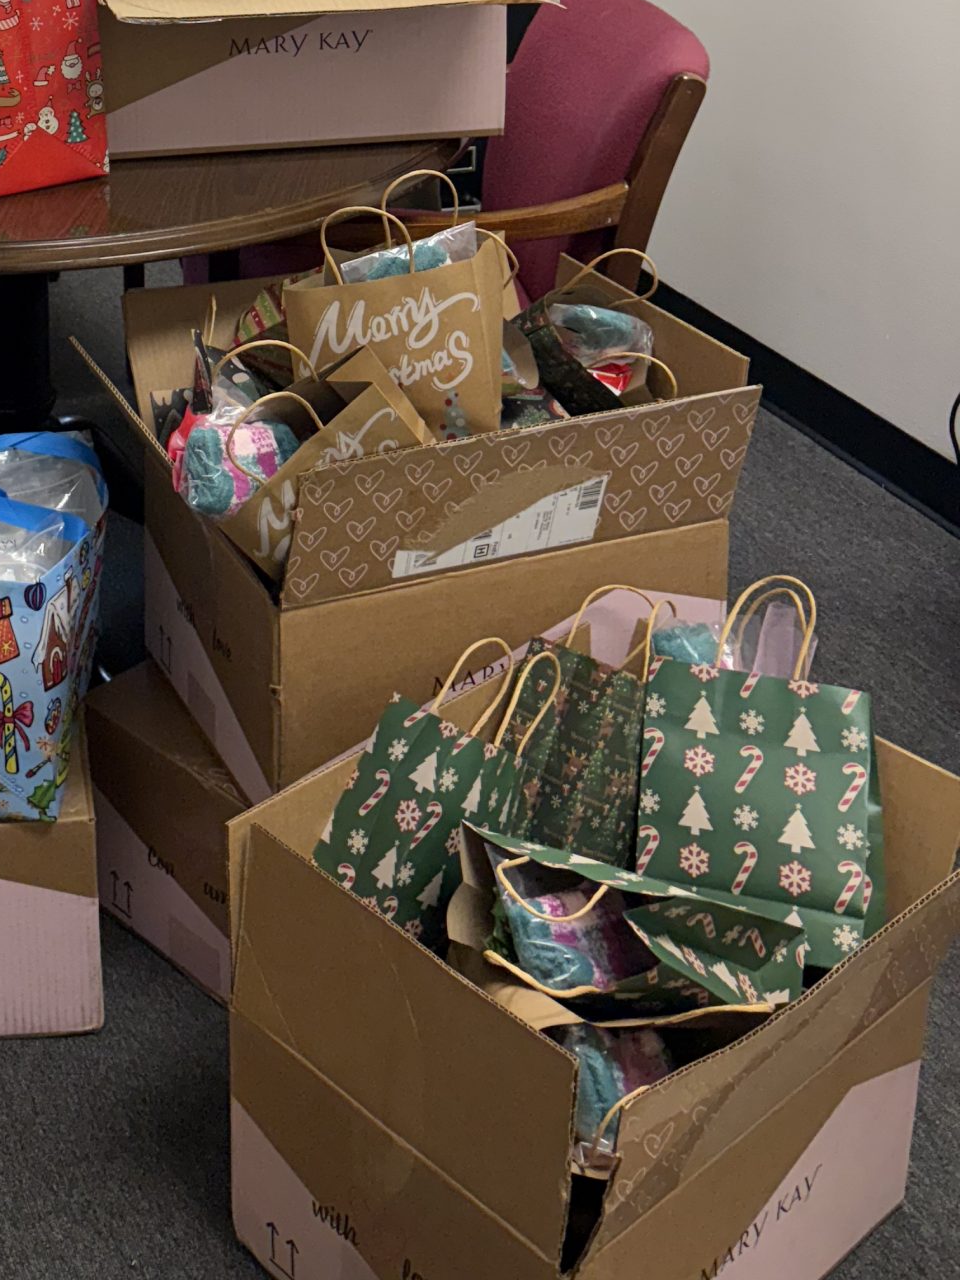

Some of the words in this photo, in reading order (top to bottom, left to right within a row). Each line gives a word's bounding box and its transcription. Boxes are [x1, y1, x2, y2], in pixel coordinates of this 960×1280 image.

[229, 33, 309, 57] MARY
[319, 29, 374, 53] KAY
[298, 286, 481, 378] Merry
[311, 1200, 361, 1247] with
[701, 1211, 769, 1280] MARY
[776, 1163, 823, 1222] KAY
